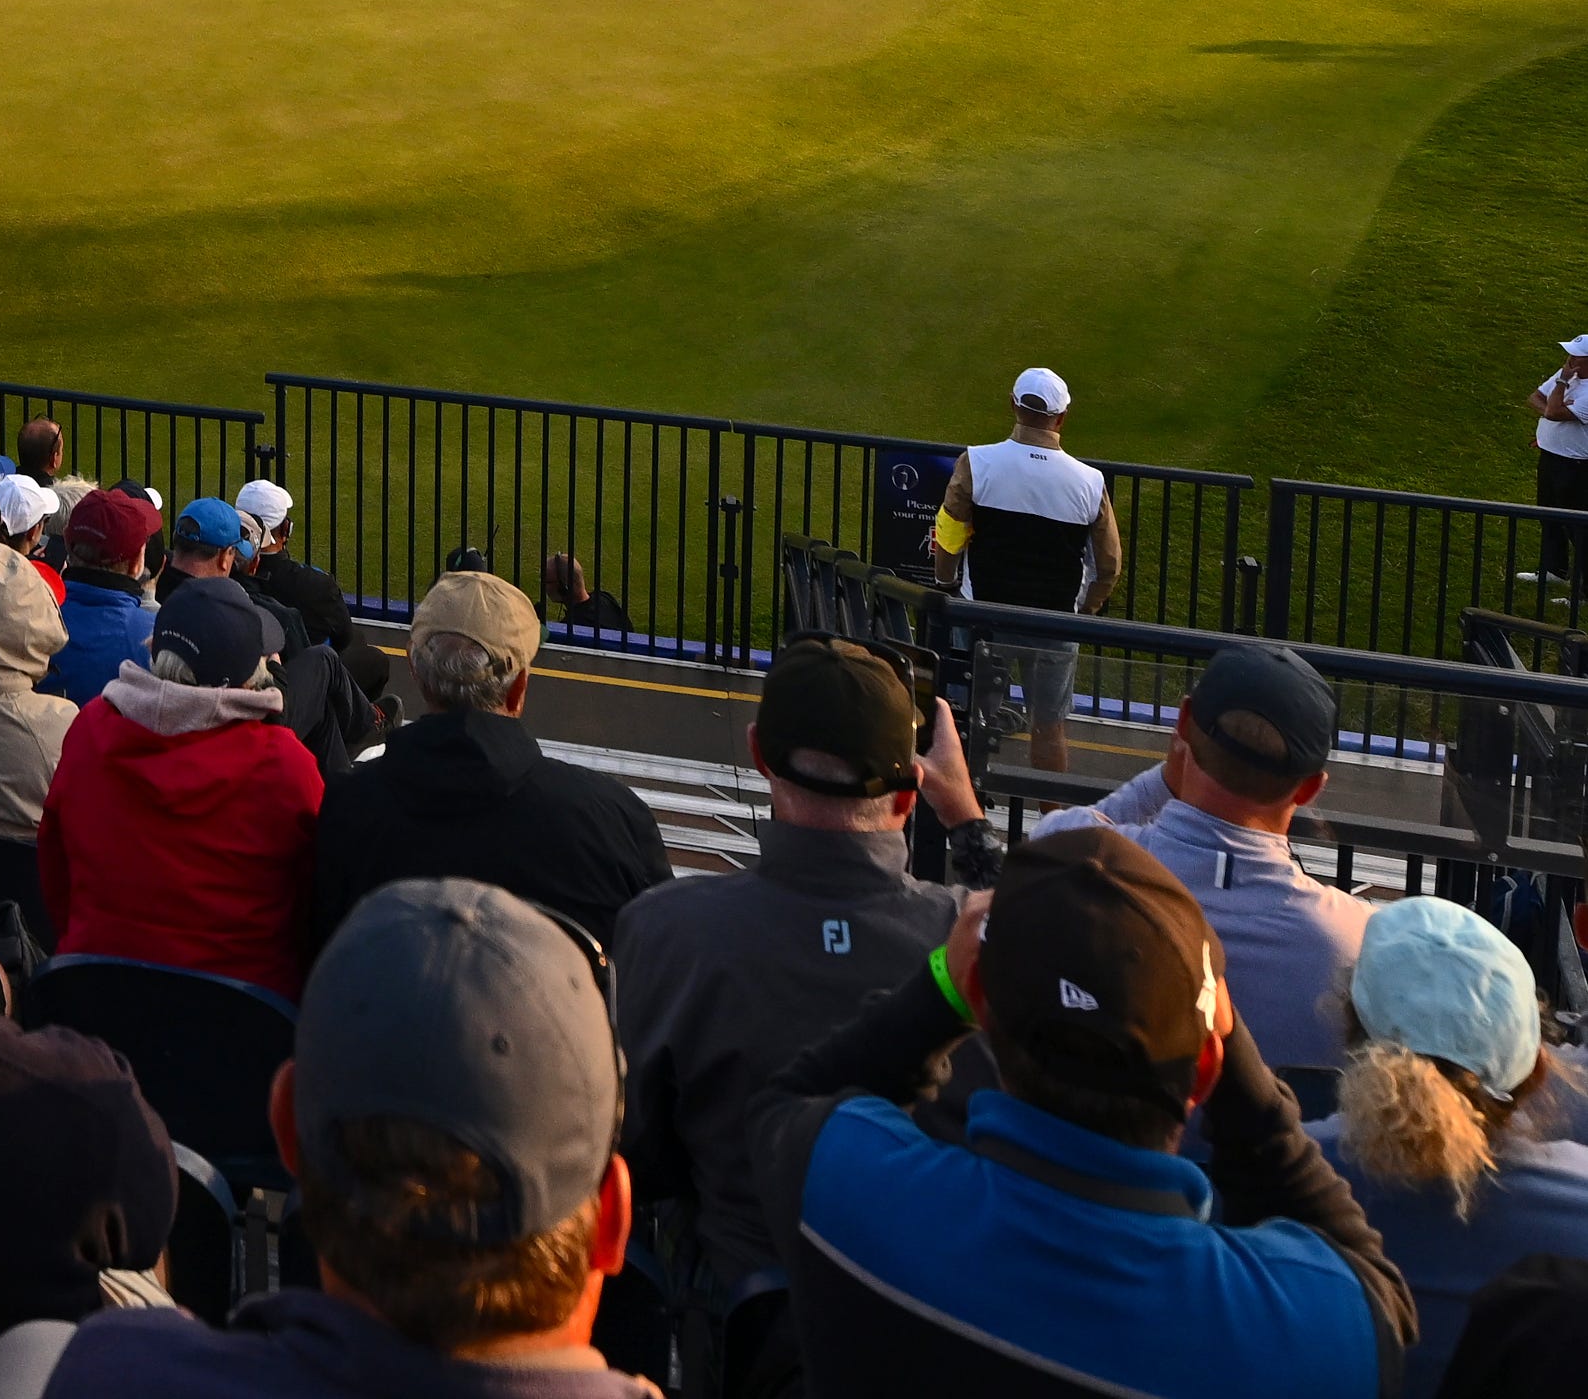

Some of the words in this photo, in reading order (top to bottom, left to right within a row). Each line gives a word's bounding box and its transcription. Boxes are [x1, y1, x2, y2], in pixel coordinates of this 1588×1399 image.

[907, 499, 937, 511] Please
[892, 510, 916, 519] your
[822, 919, 851, 954] FJ
